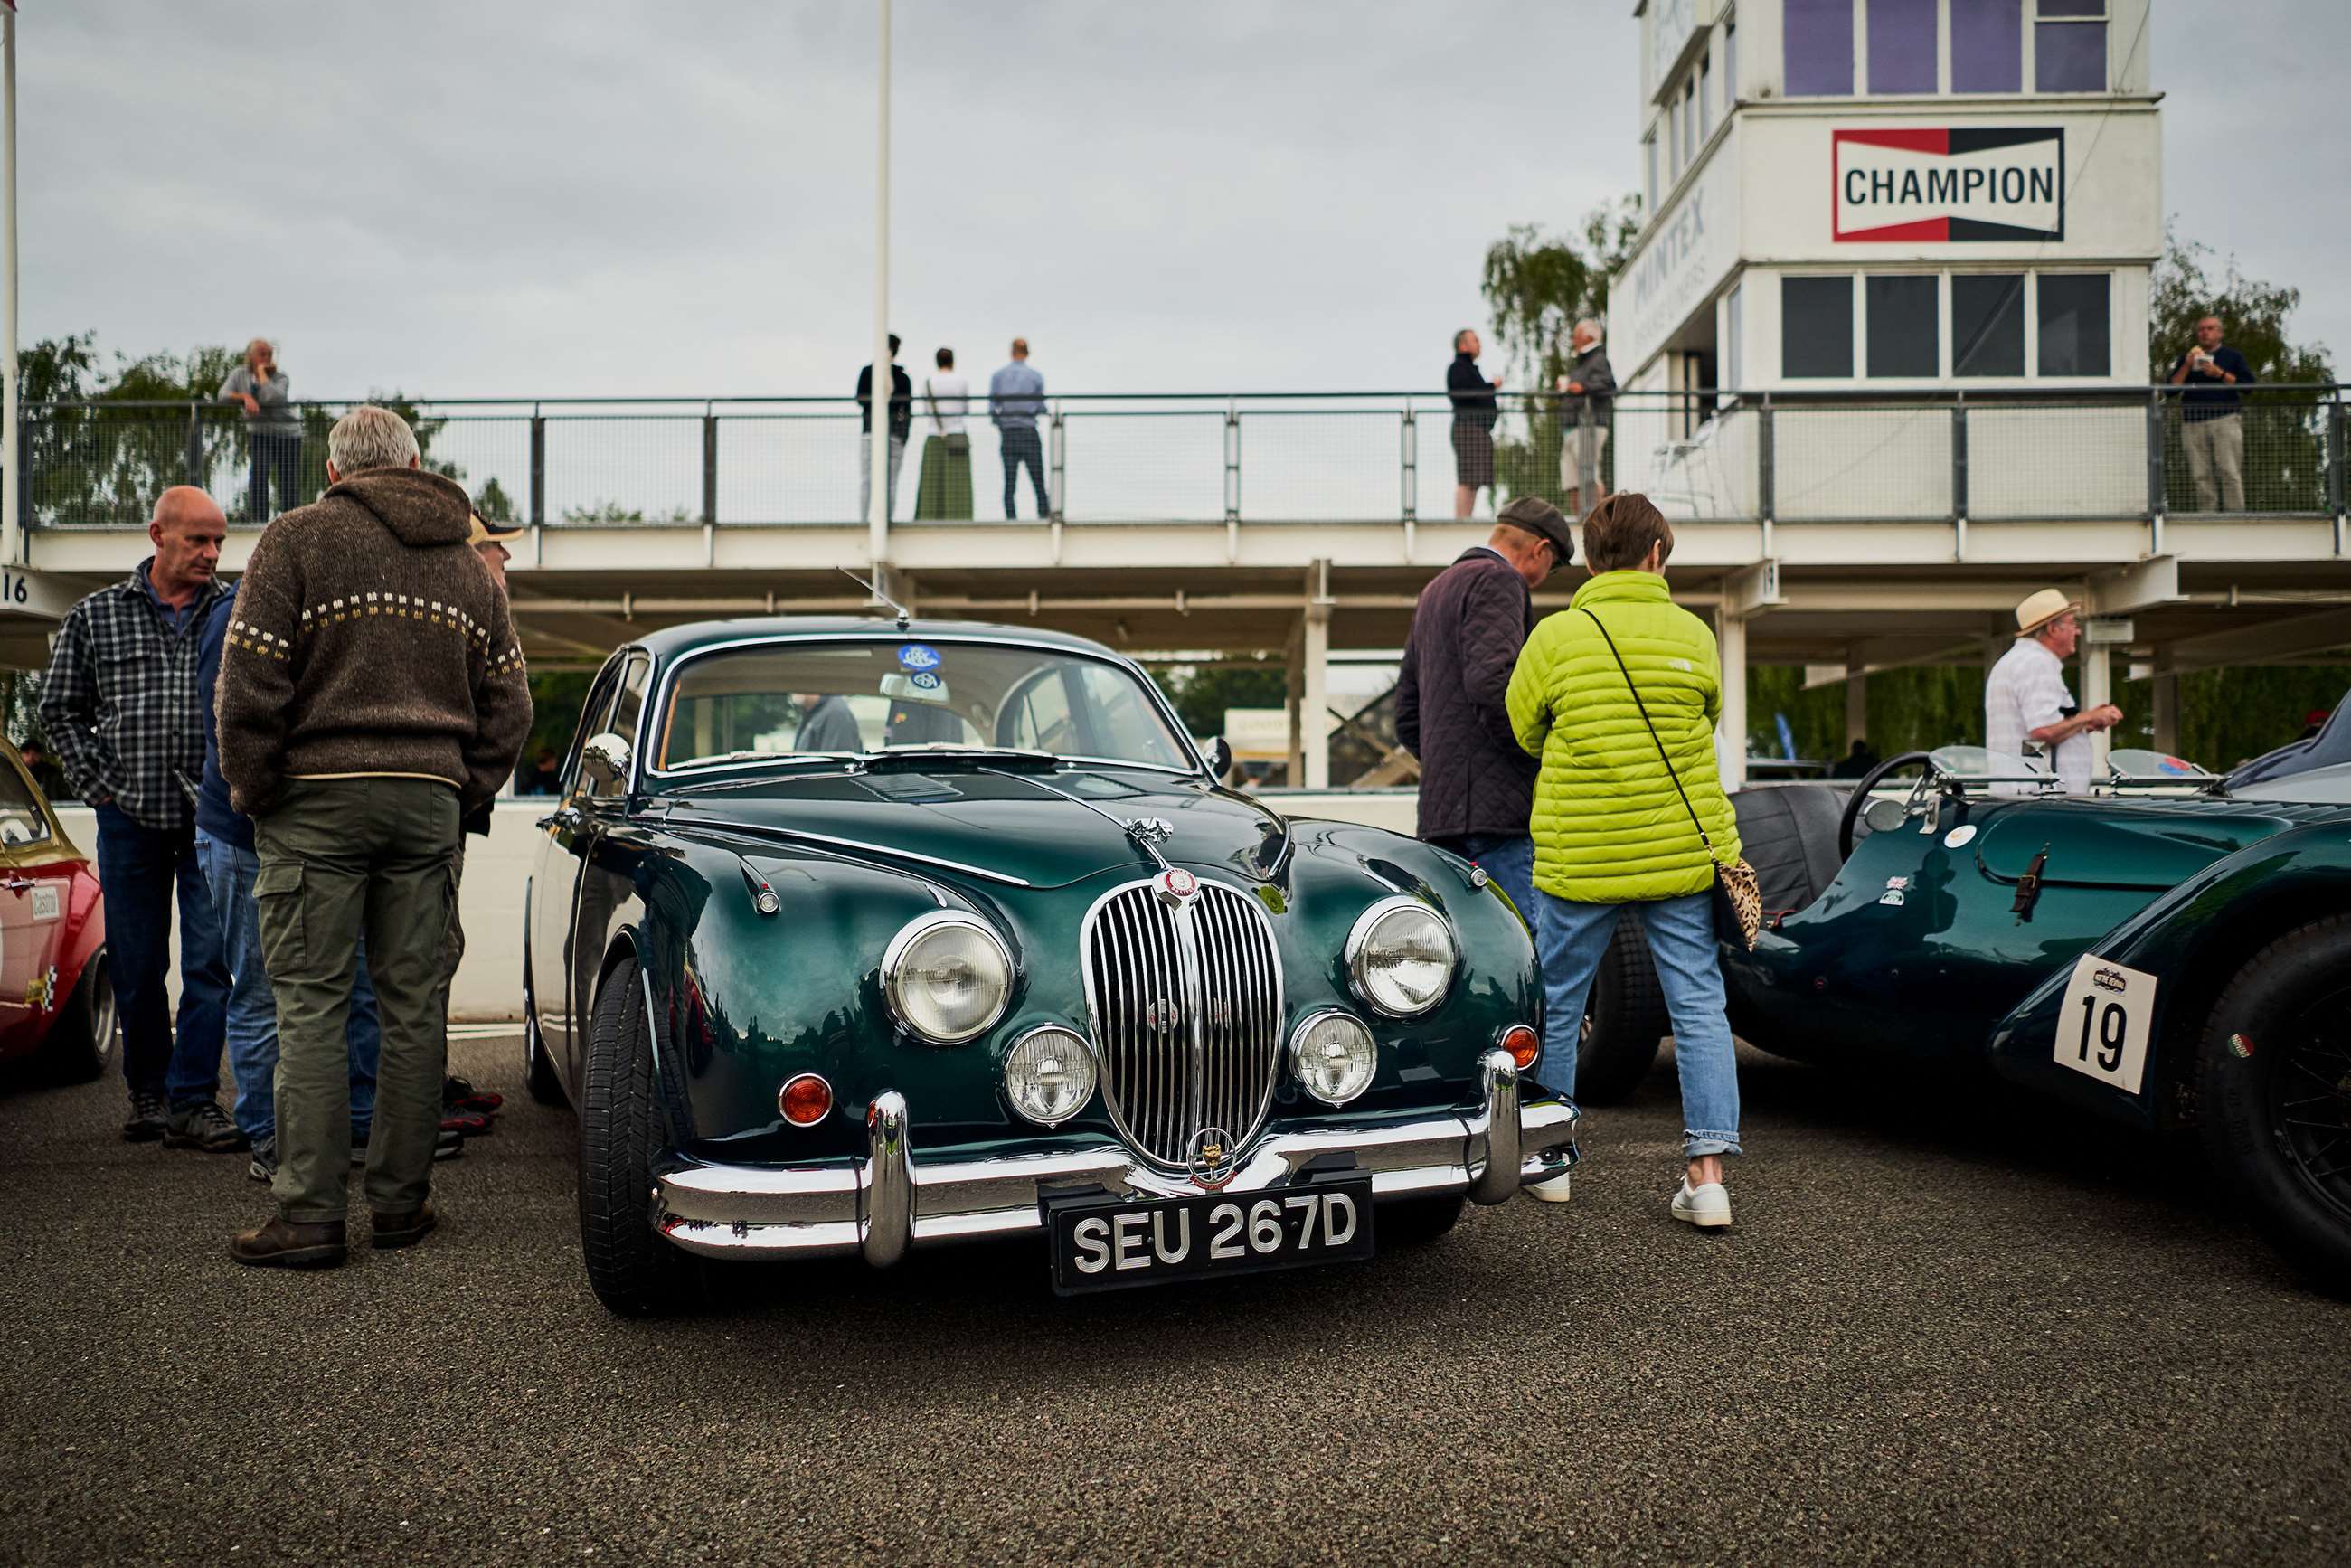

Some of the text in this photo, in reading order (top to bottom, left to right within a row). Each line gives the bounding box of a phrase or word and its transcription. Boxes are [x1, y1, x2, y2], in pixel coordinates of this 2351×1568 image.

[1845, 167, 2053, 204] CHAMPION
[1634, 185, 1704, 309] MINTEX
[4, 571, 28, 605] 16
[2078, 994, 2128, 1072] 19
[1074, 1192, 1357, 1274] SEU 267D
